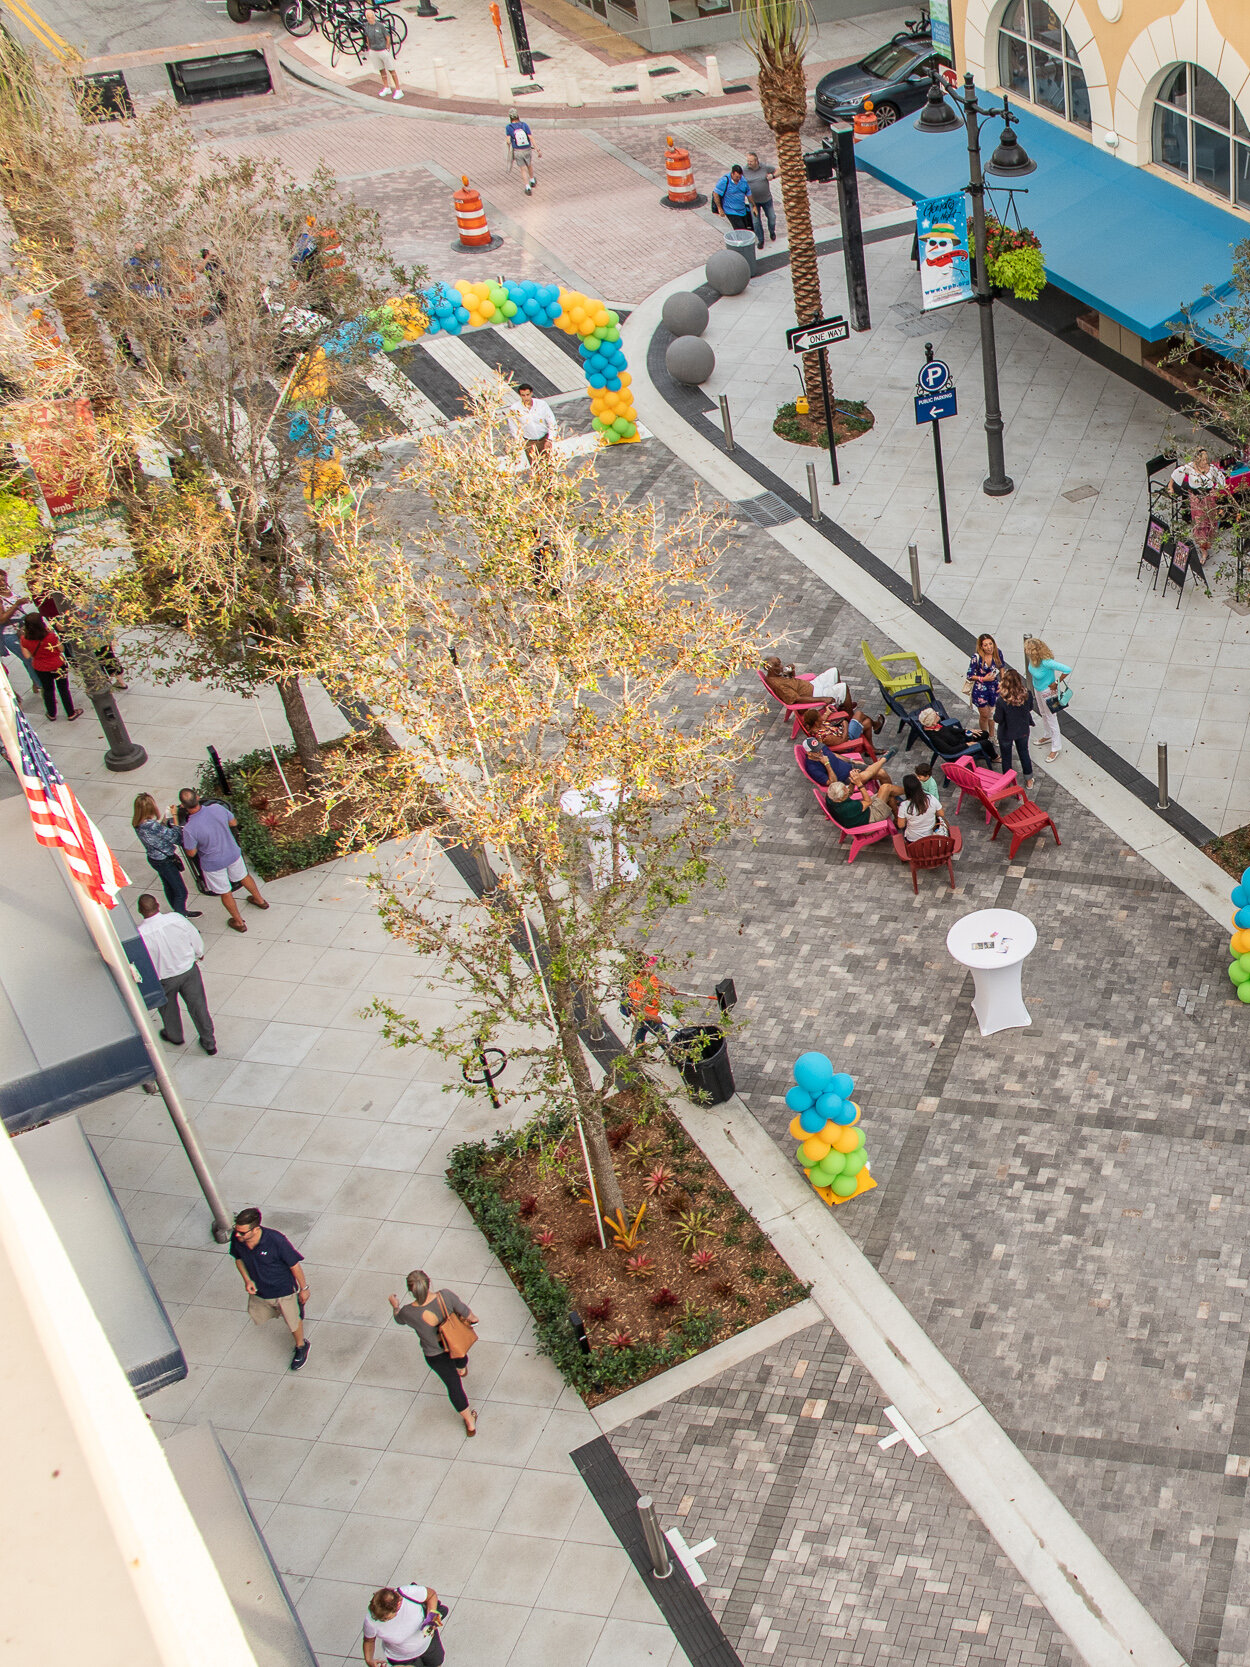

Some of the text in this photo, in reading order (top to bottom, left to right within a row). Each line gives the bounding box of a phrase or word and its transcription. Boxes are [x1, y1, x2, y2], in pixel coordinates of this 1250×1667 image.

[924, 280, 969, 295] www.wpb.org
[809, 327, 844, 344] ONE WAY
[926, 366, 942, 387] P
[918, 392, 953, 406] PUBLIC PARKING
